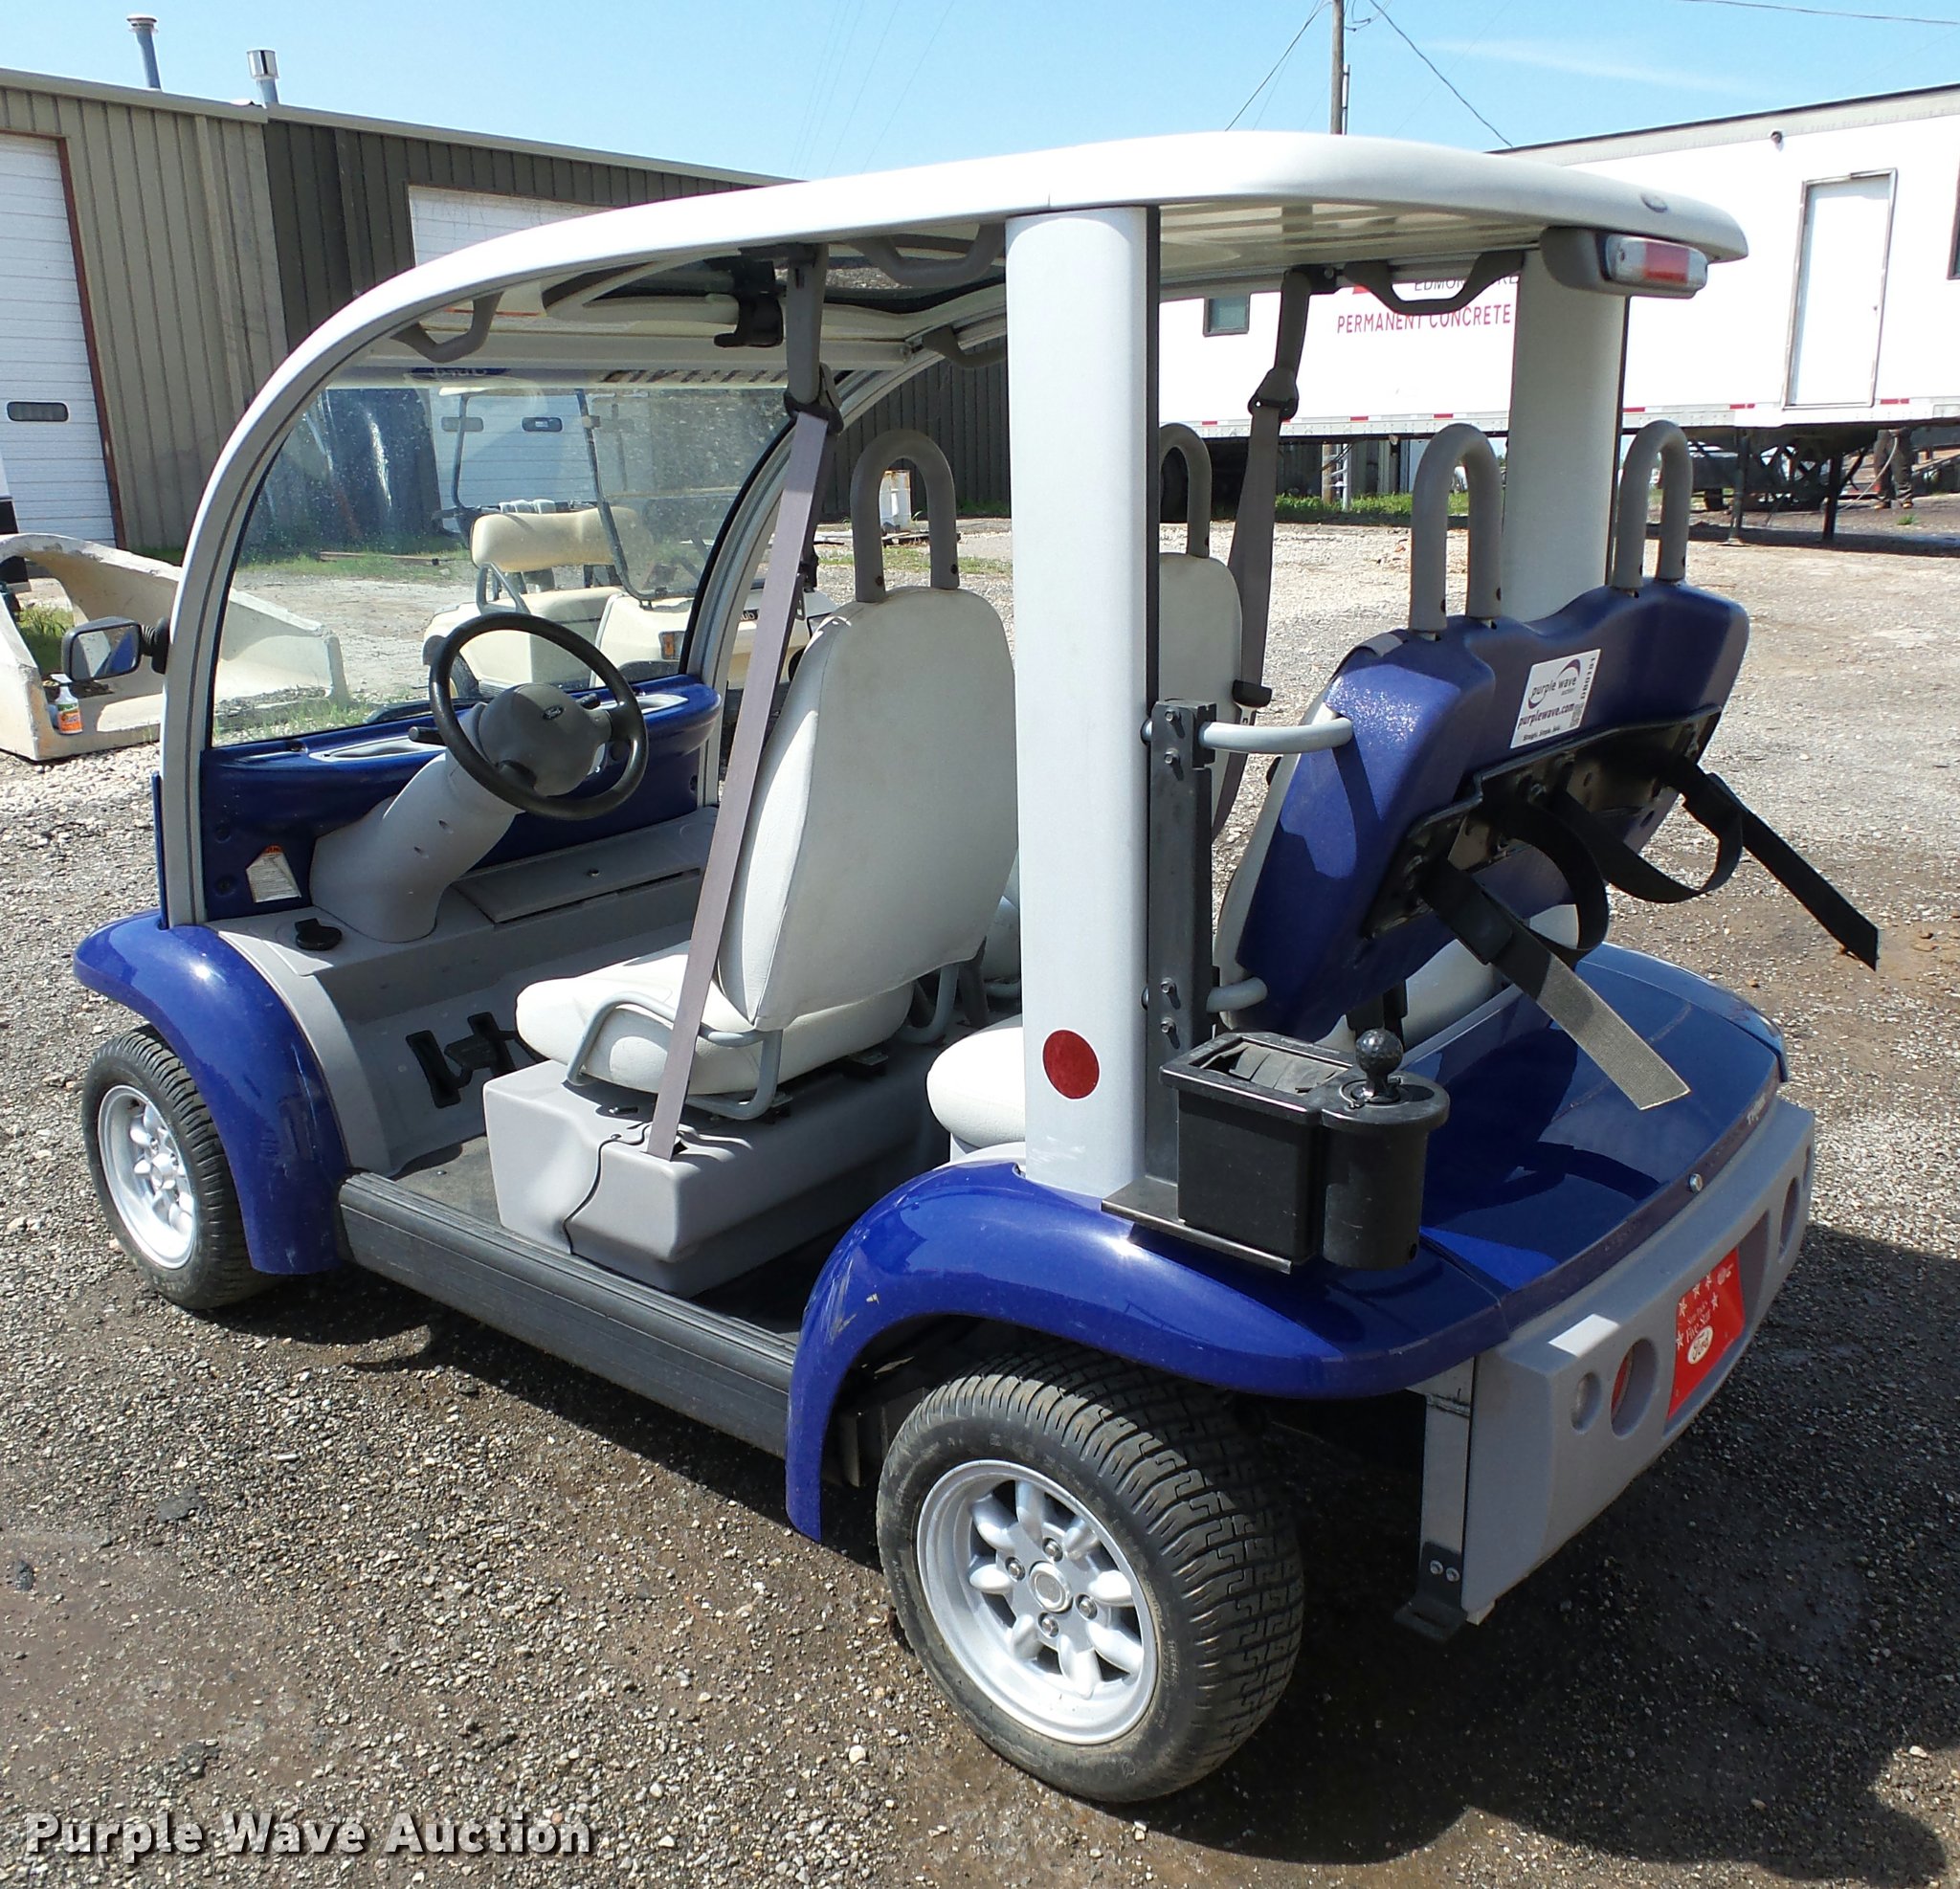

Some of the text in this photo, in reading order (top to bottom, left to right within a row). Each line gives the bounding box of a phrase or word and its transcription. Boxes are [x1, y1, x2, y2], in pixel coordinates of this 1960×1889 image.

[1337, 304, 1511, 334] PERMANENT CONCRETE
[1531, 679, 1557, 698] purple
[1558, 677, 1576, 689] wave
[1518, 703, 1575, 729] purplewave.com
